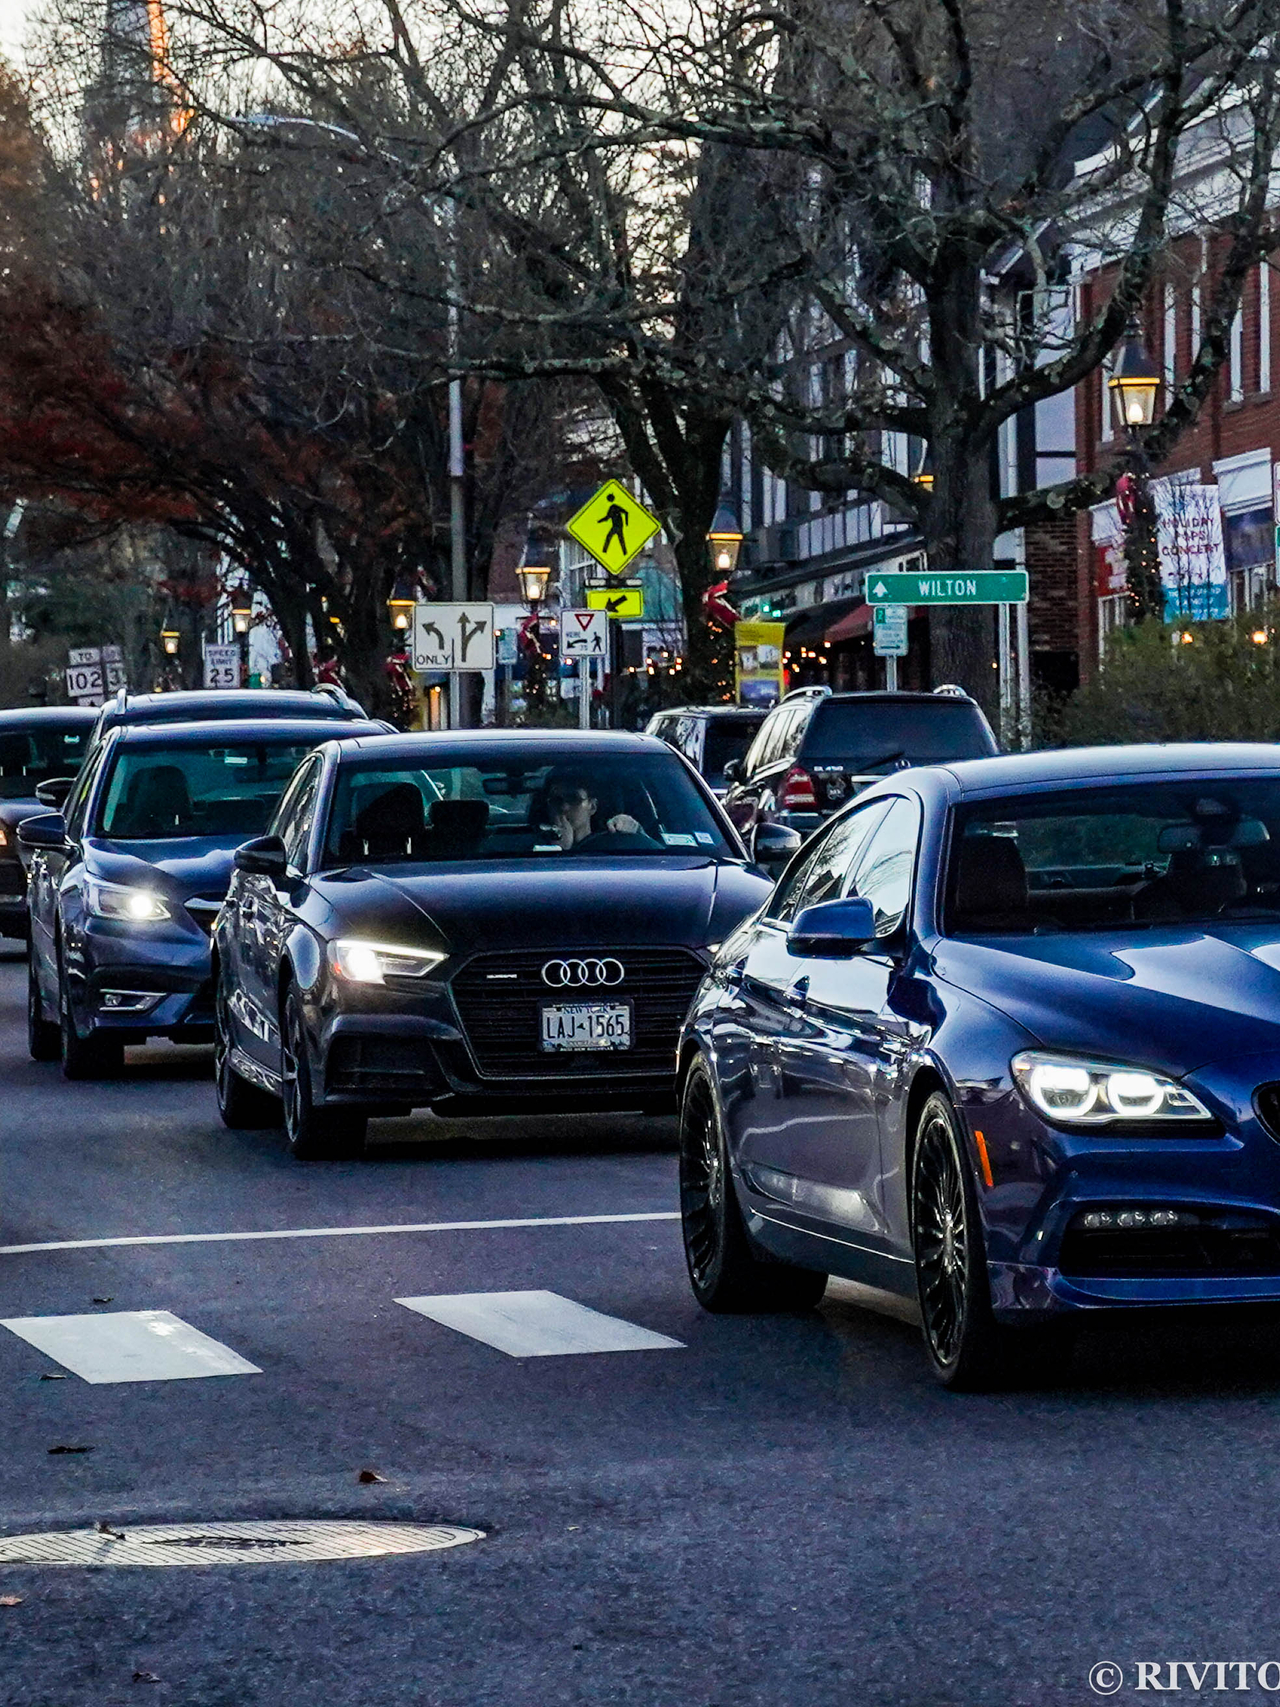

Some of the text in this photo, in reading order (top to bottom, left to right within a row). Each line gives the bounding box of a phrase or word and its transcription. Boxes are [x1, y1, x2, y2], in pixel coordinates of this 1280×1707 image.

[918, 579, 977, 597] WILTON
[416, 654, 450, 665] ONLY
[69, 671, 103, 690] 102
[210, 667, 234, 684] 25
[546, 1014, 626, 1039] LAJ 1565
